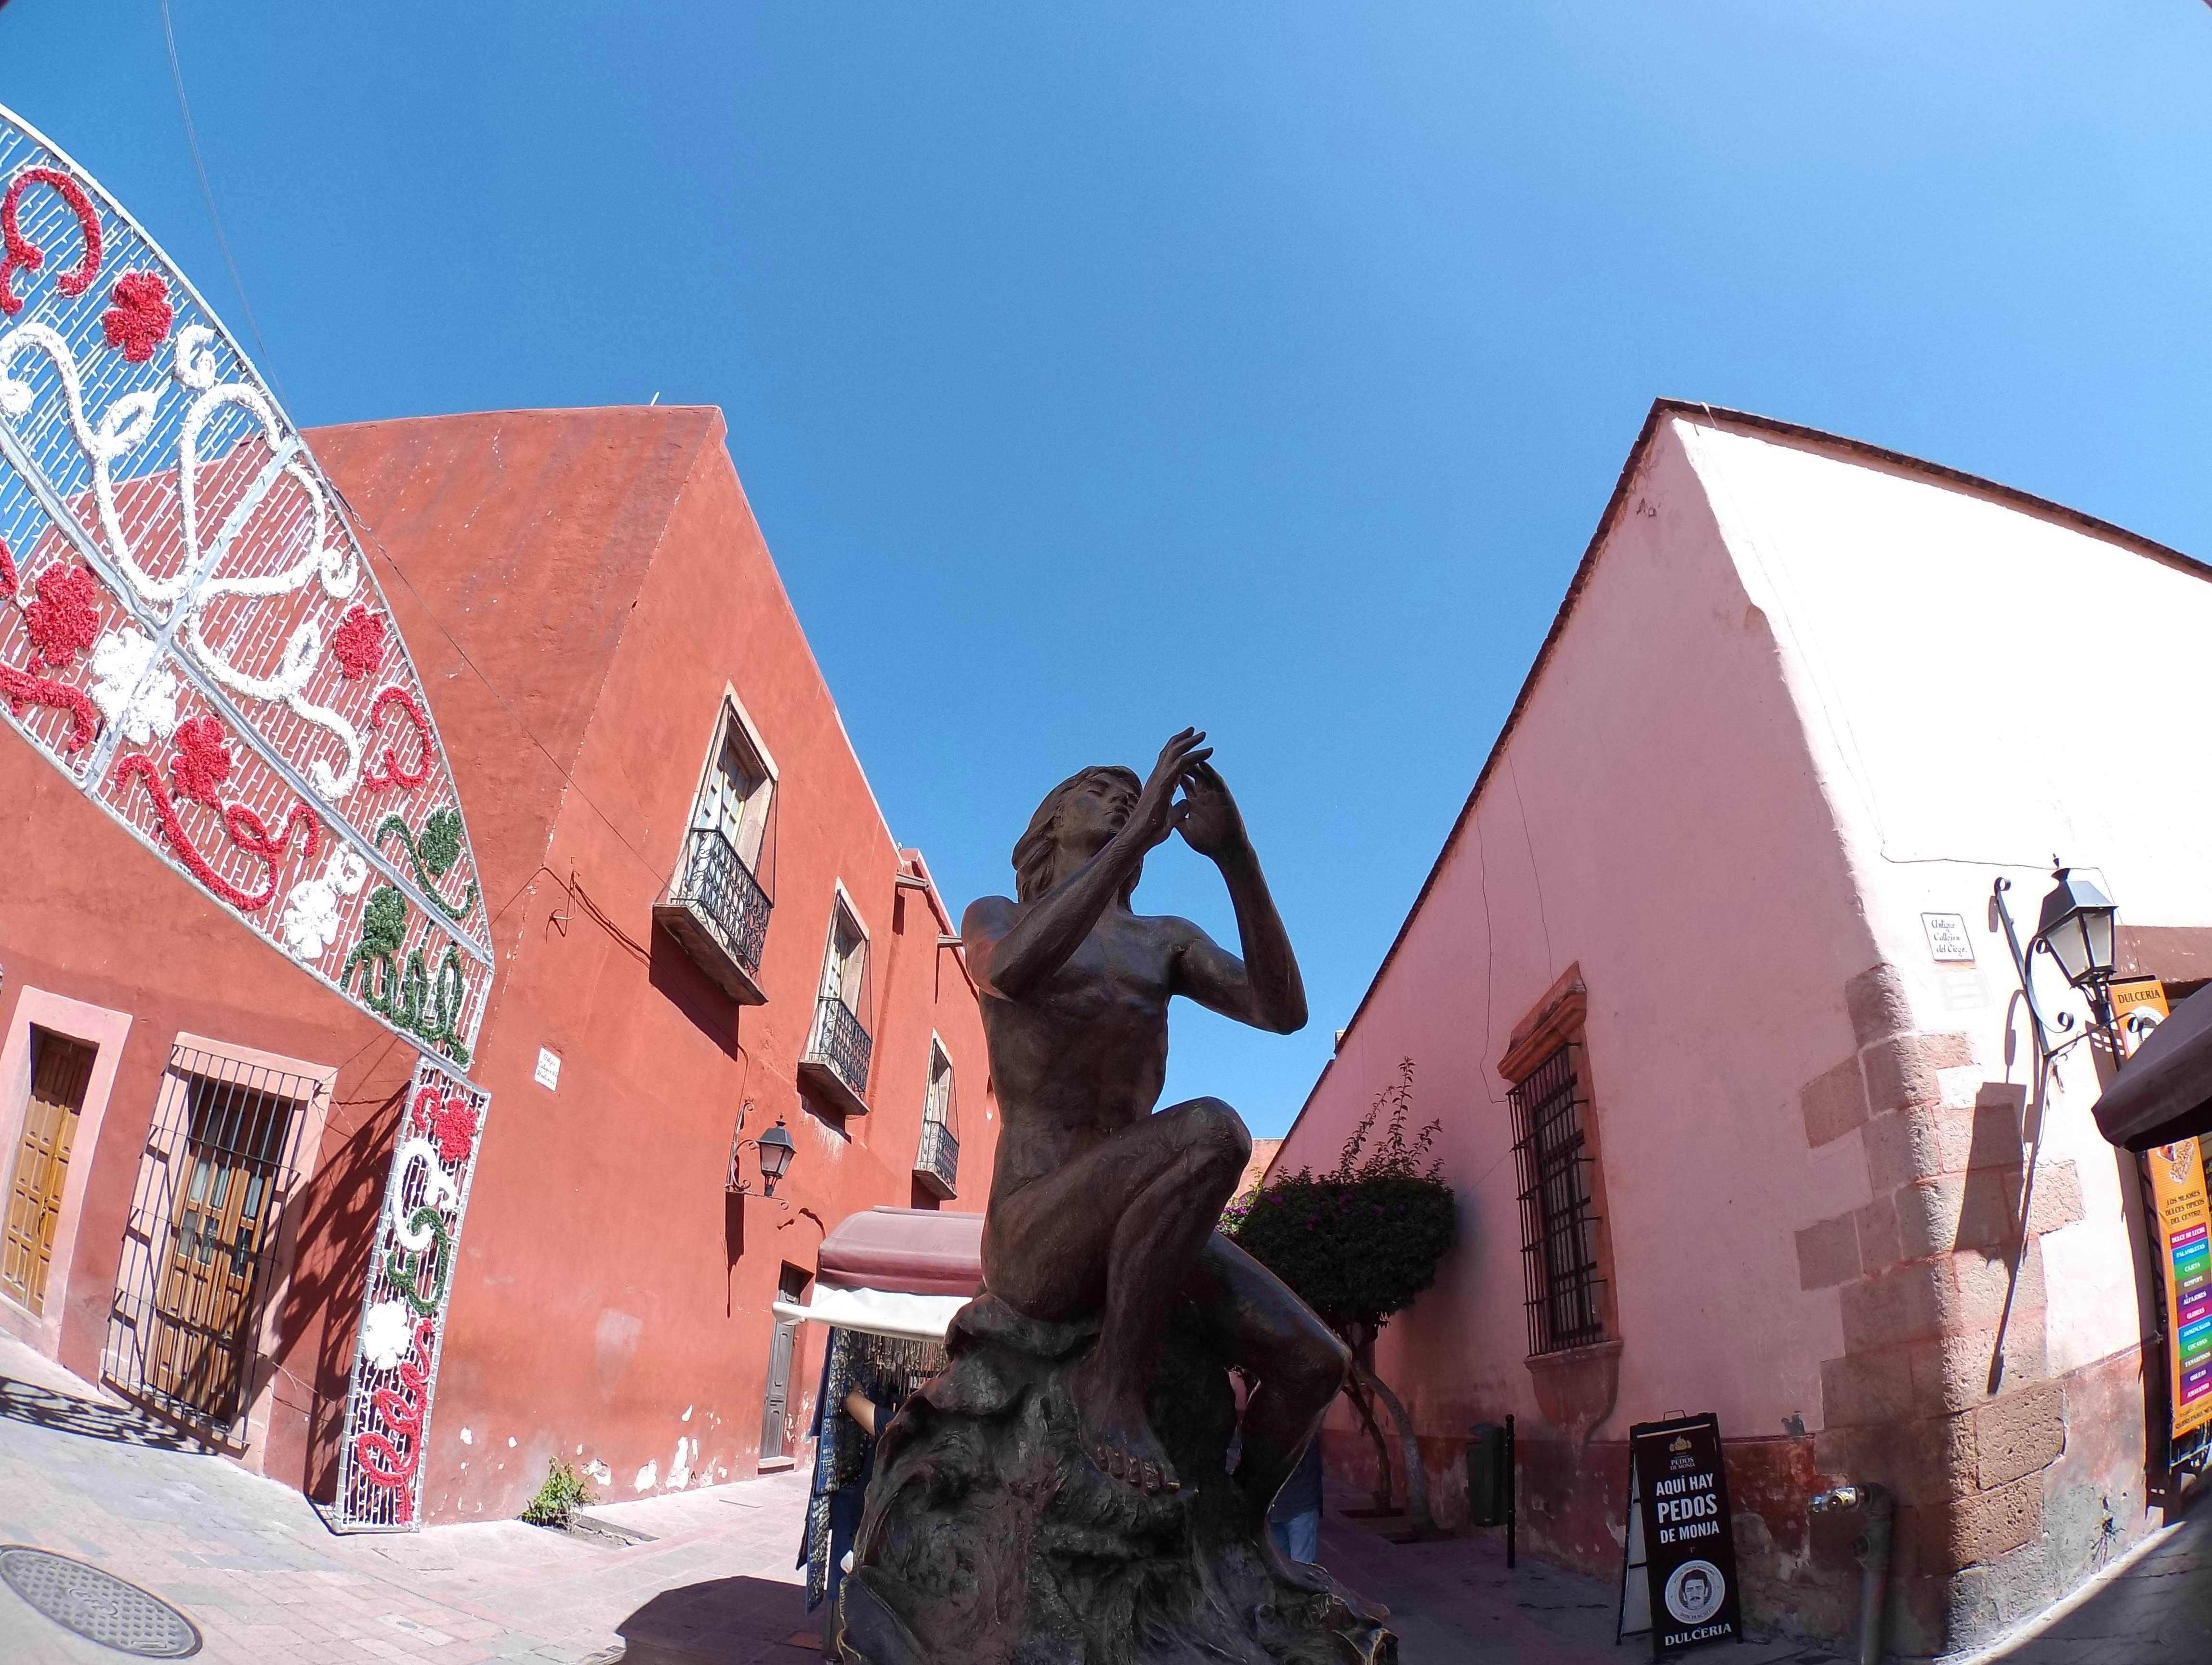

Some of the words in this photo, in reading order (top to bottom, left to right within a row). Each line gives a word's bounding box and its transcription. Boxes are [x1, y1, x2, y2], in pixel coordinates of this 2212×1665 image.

[1936, 944, 1946, 952] del
[2178, 1190, 2200, 1201] MEJORES
[2165, 1206, 2185, 1216] DULCES
[2172, 1234, 2186, 1243] DULCE
[2184, 1262, 2201, 1272] CAJETA
[1671, 1456, 1694, 1466] PEDOS
[1656, 1475, 1686, 1496] AQUÍ
[1689, 1473, 1713, 1491] HAY
[1657, 1493, 1718, 1523] PEDOS
[1660, 1528, 1676, 1544] DE
[1679, 1520, 1720, 1540] MONJA
